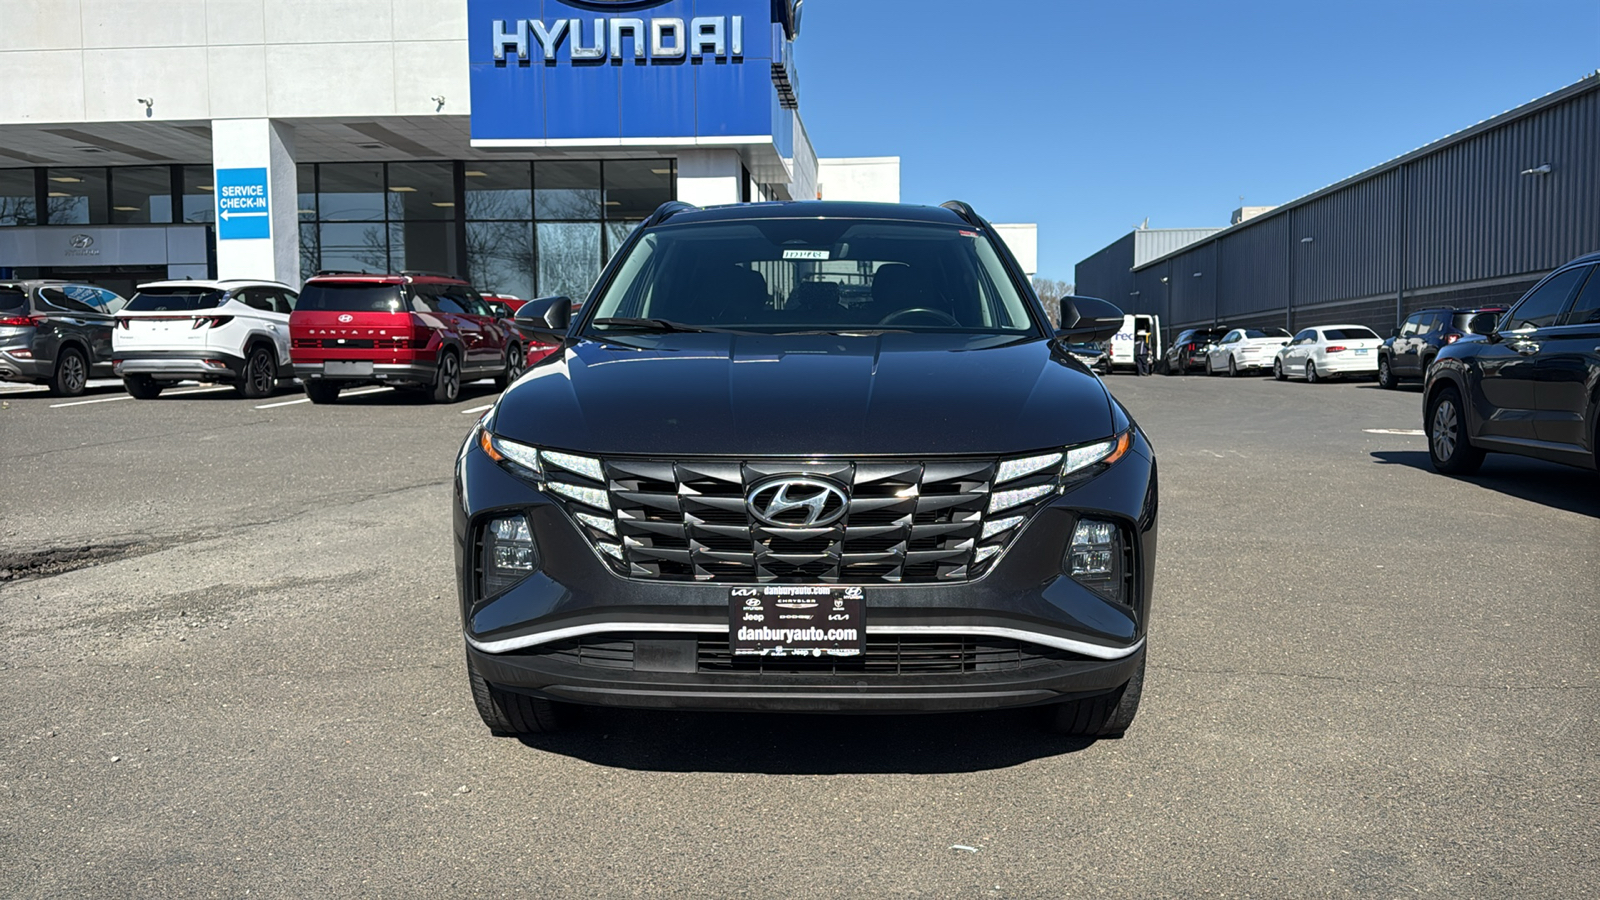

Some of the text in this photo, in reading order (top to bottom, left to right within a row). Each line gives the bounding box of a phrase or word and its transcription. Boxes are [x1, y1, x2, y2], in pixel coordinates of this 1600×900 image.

[492, 15, 743, 60] HYUNDAI
[222, 185, 263, 196] SERVICE
[220, 197, 266, 208] CHECK-IN
[764, 586, 830, 595] danburyauto.com
[742, 612, 765, 622] Jeep
[738, 626, 857, 643] danburyauto.com
